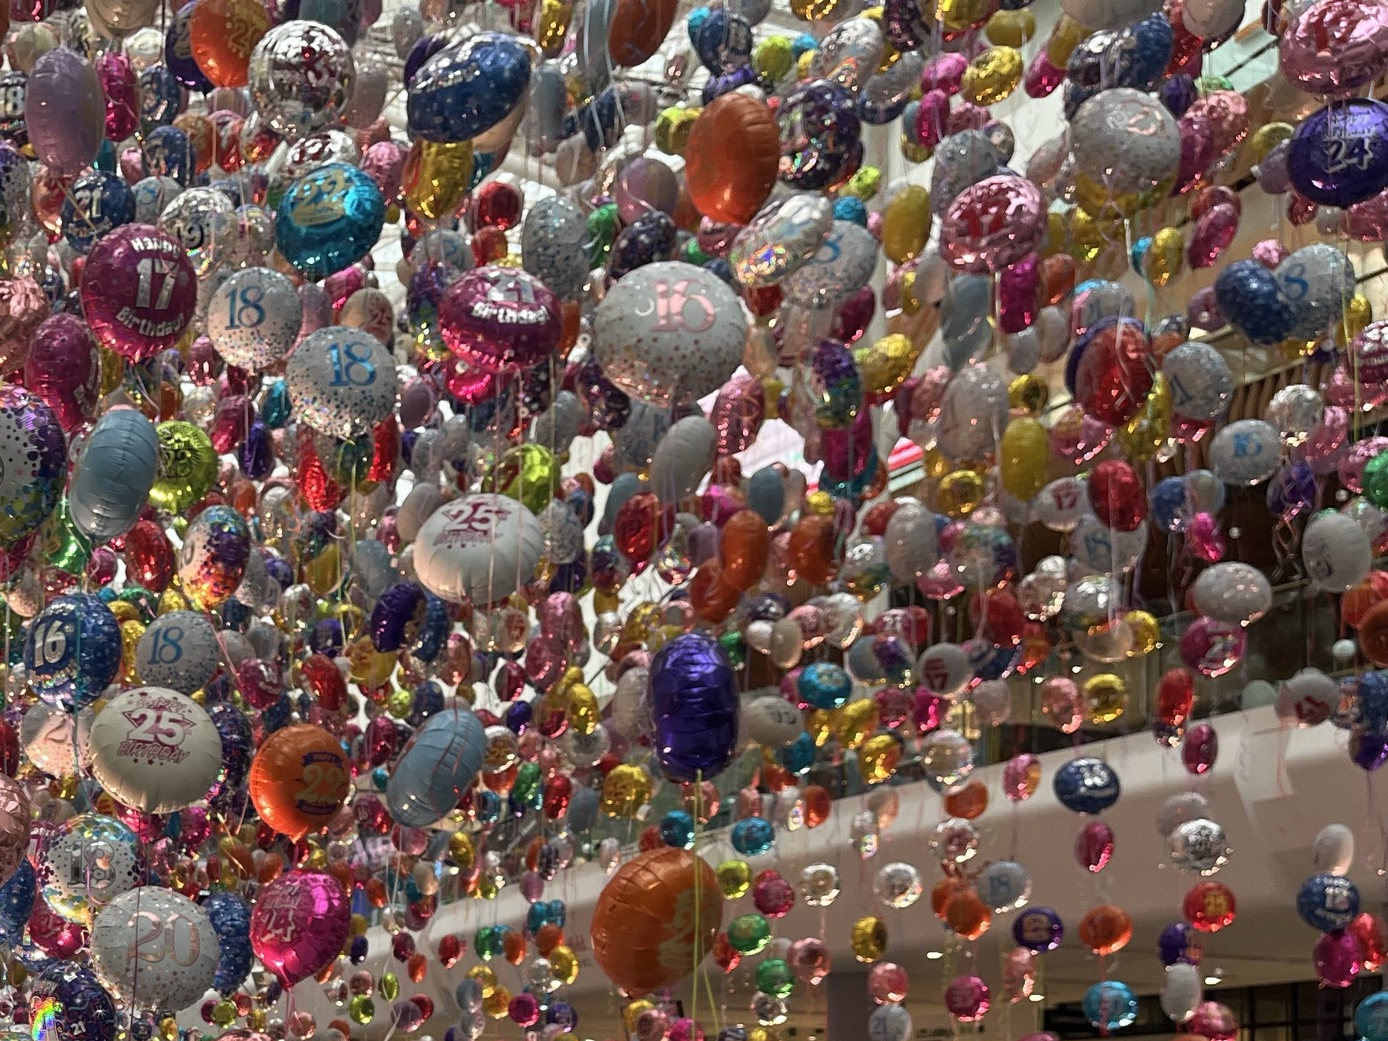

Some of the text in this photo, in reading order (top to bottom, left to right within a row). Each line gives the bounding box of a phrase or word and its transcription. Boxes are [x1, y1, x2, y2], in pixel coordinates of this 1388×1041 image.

[1323, 137, 1375, 175] 24
[136, 258, 180, 310] 17
[225, 286, 267, 331] 18
[651, 278, 715, 333] 16
[329, 342, 377, 387] 18
[444, 503, 494, 532] 25
[33, 620, 67, 668] 16
[147, 626, 185, 665] 18
[127, 707, 186, 747] 25
[116, 741, 192, 765] BIRTHDAY
[65, 841, 116, 890] 18
[127, 910, 200, 967] 20
[260, 908, 296, 943] 24
[69, 1021, 87, 1036] 21
